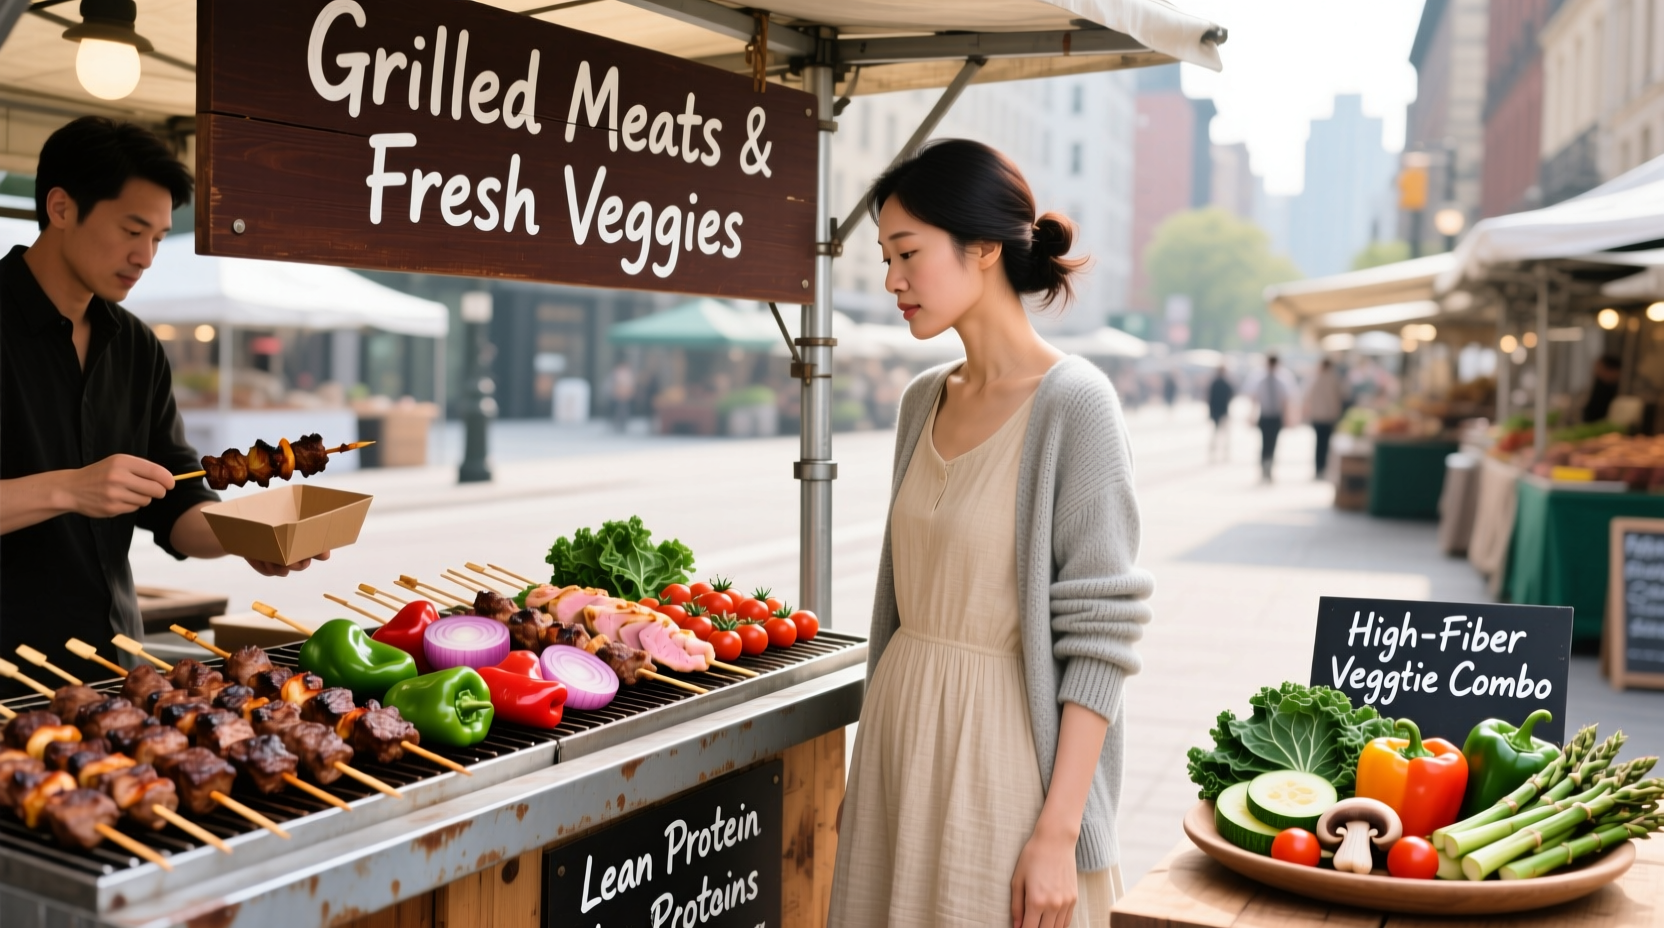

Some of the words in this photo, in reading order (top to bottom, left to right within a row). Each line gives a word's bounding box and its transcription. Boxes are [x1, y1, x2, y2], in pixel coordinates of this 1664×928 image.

[307, 0, 542, 135] Grilled
[564, 60, 723, 167] Meats
[739, 106, 773, 179] &
[365, 132, 540, 236] Fresh
[563, 164, 744, 279] Veggies
[1331, 655, 1439, 706] Veggtie
[1448, 660, 1553, 700] Combo
[1347, 610, 1528, 663] High-Fiber
[580, 853, 653, 914] Lean
[663, 802, 762, 875] Protein
